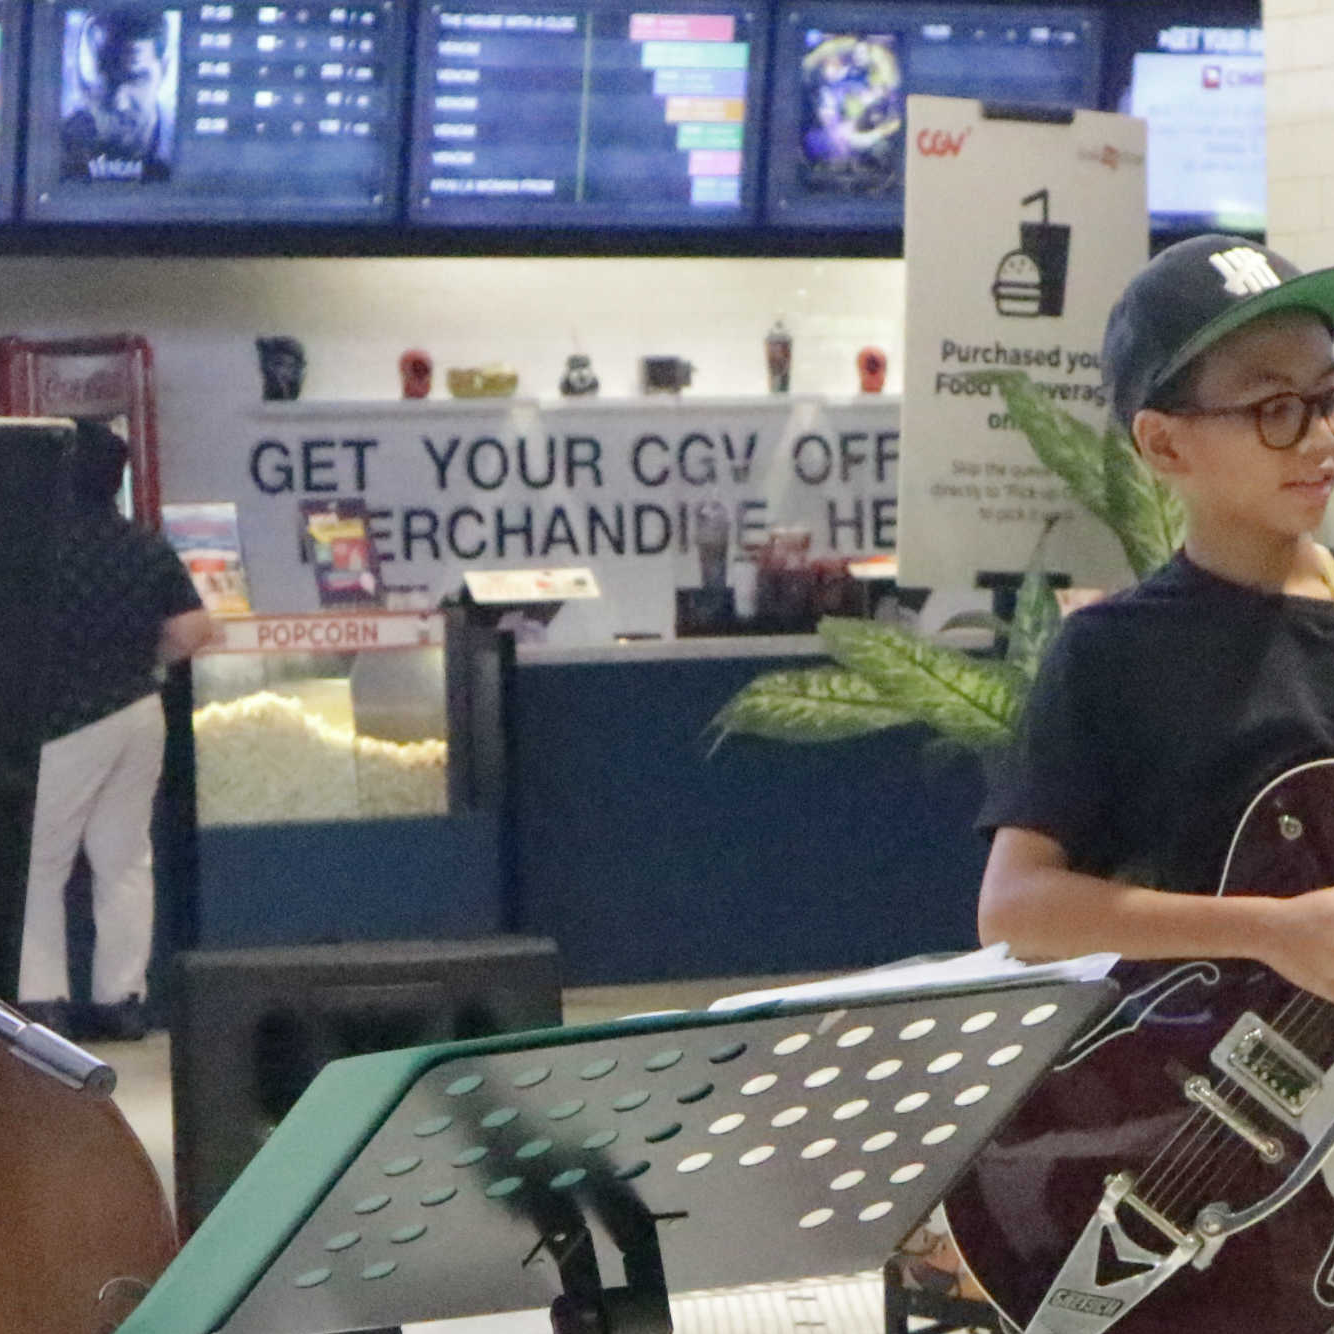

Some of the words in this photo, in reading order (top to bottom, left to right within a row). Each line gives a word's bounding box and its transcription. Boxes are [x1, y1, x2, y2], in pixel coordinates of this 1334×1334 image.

[941, 339, 1062, 367] Purchased
[250, 440, 377, 494] GET
[422, 436, 604, 491] YOUR
[631, 433, 759, 489] CGV
[300, 502, 767, 562] ERCHANDIE
[258, 622, 379, 647] POPCORN
